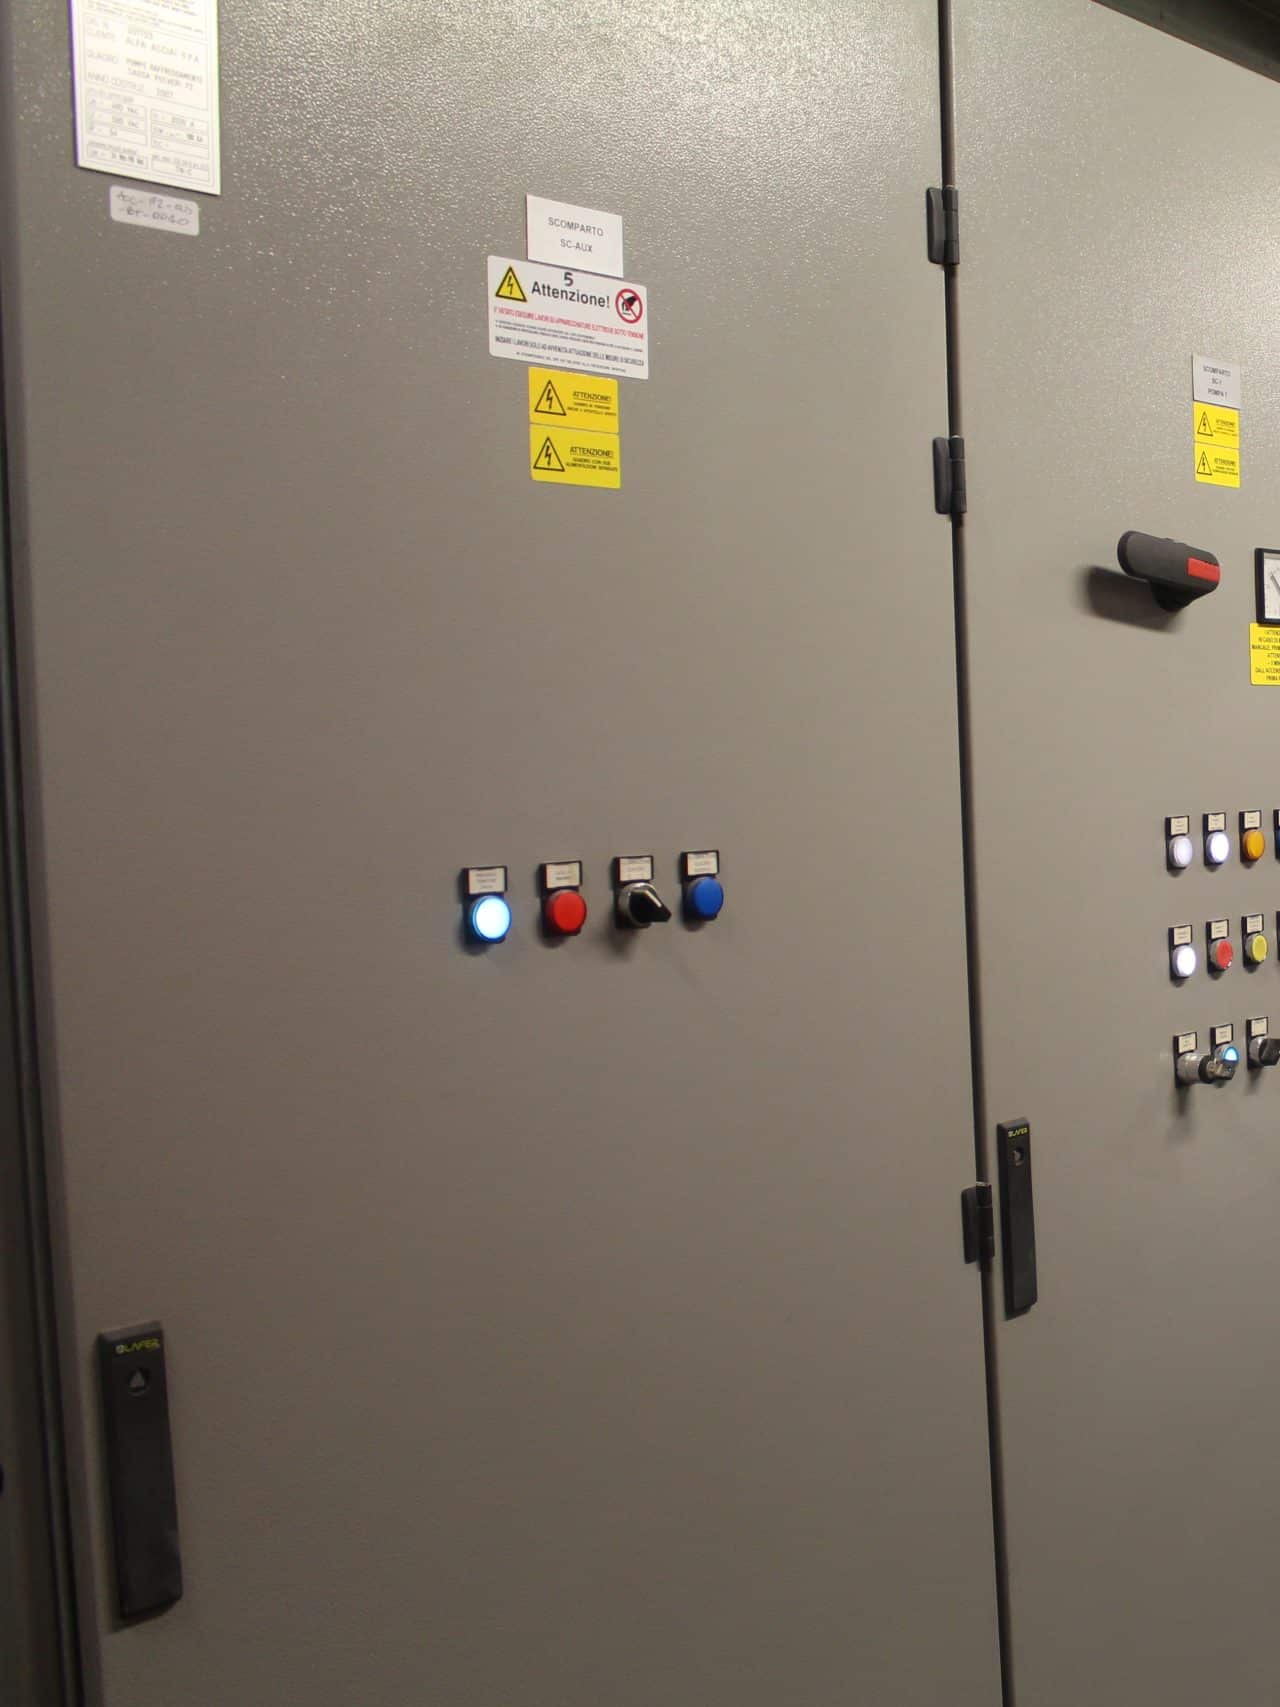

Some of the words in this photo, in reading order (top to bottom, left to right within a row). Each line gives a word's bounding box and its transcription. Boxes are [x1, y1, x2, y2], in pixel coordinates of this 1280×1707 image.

[547, 216, 604, 237] SCOMPARTO
[560, 238, 593, 253] SC-AUX
[563, 271, 574, 287] 5
[531, 280, 610, 308] Attenzione!
